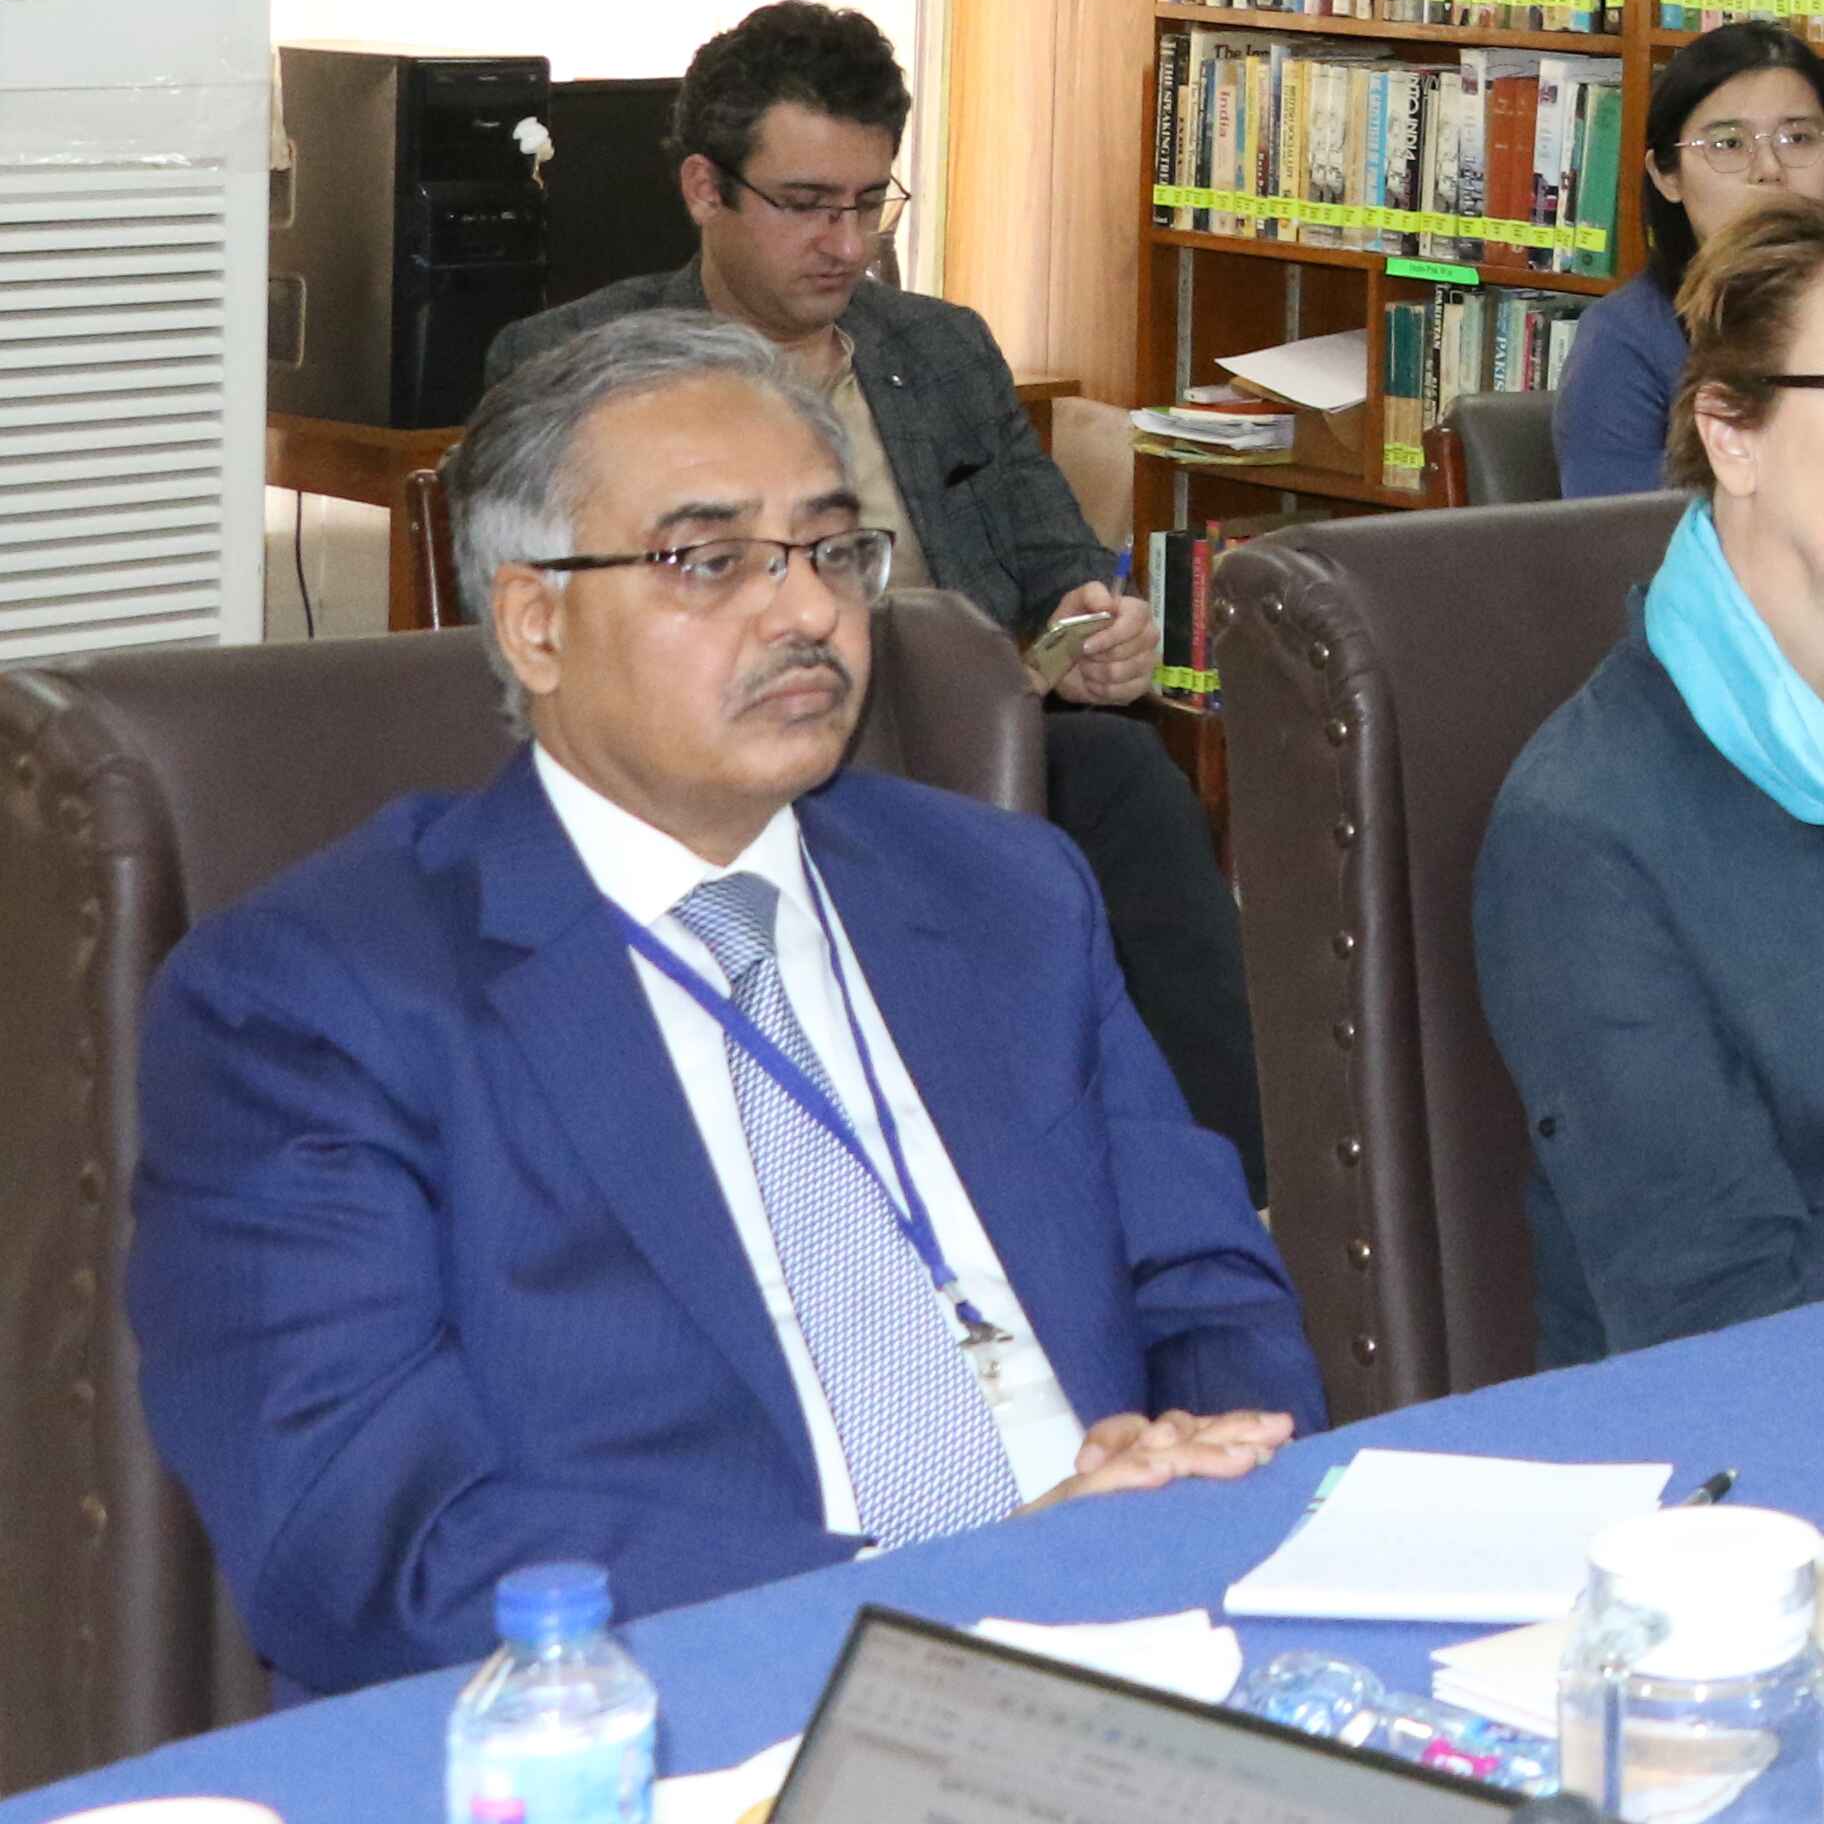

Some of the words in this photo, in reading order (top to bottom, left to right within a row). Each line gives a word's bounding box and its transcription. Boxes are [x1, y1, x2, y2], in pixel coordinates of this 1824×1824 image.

[1163, 63, 1174, 86] THE
[1406, 74, 1420, 115] INTO
[1160, 90, 1173, 155] SPEAKING
[1218, 90, 1231, 138] India
[1406, 117, 1419, 161] INDIA
